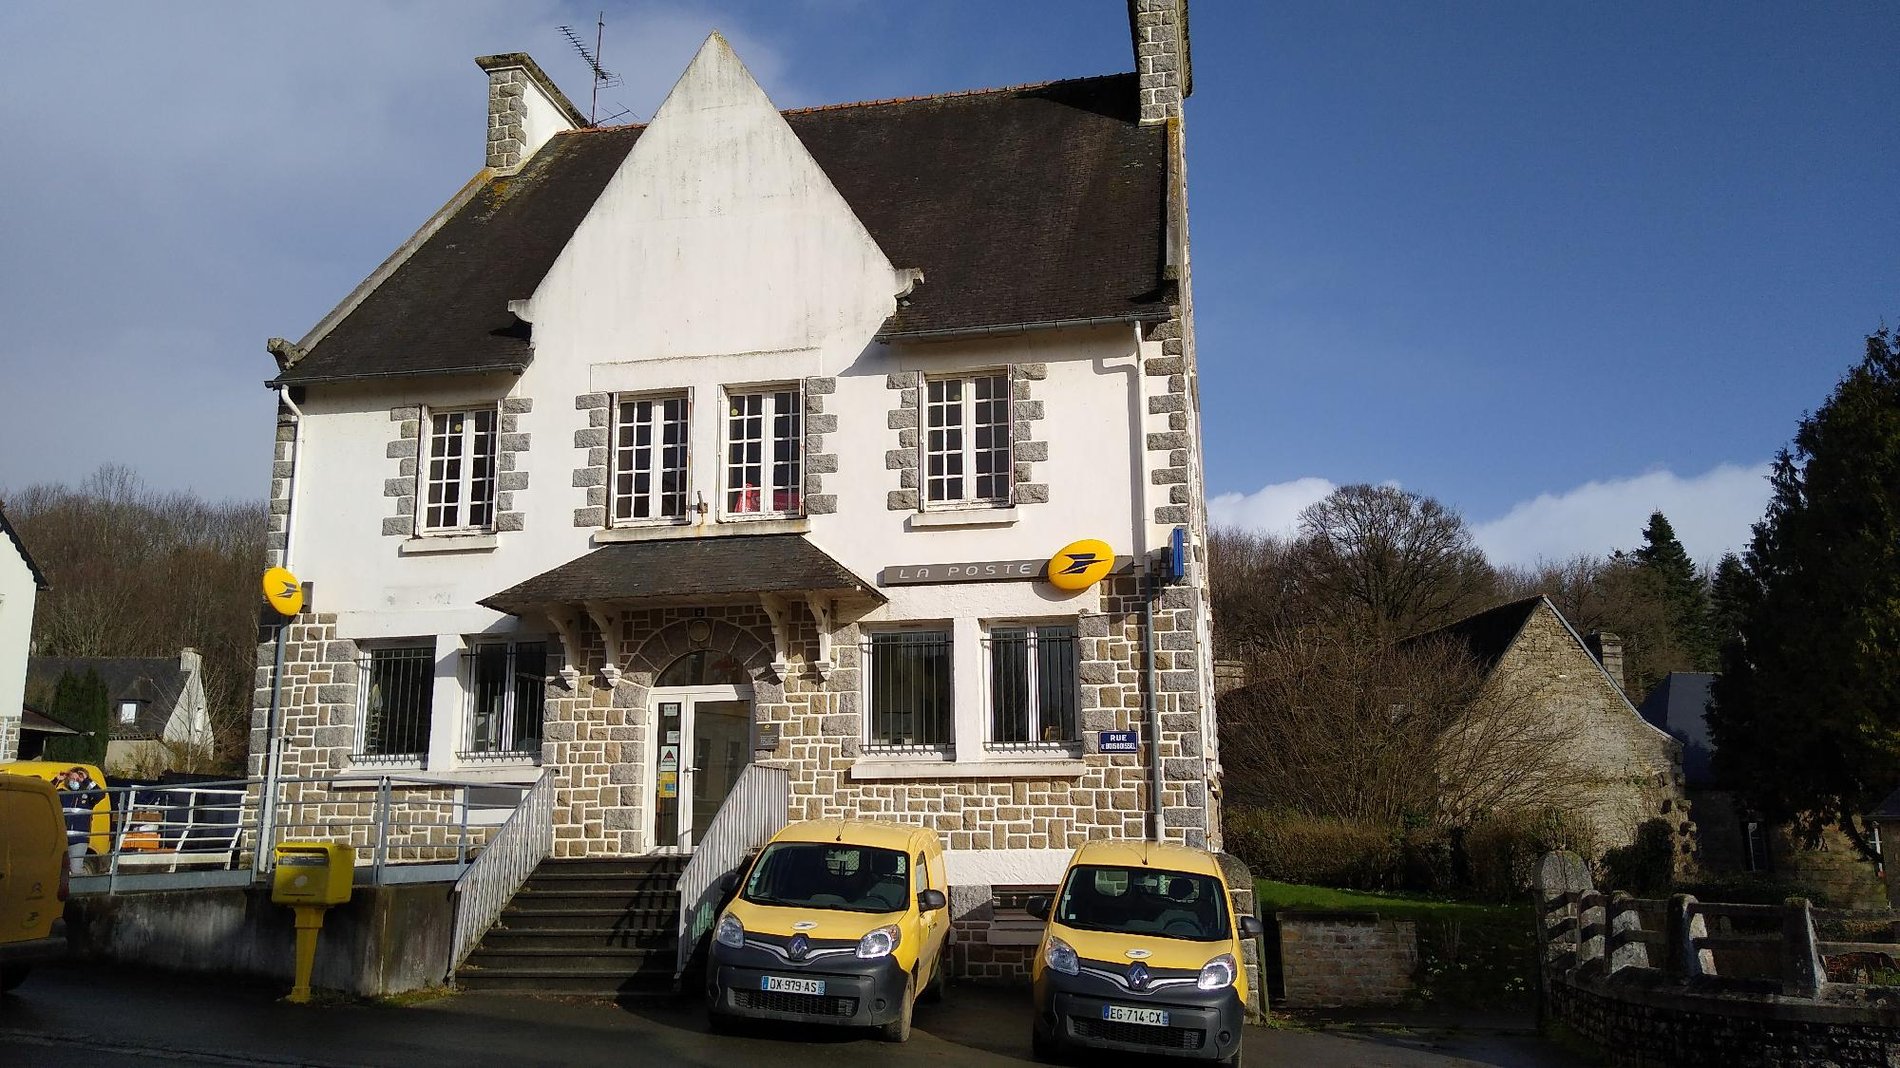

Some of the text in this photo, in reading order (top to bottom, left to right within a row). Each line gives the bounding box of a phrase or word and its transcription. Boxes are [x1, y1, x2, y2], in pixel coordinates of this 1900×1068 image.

[899, 563, 1033, 579] LA POSTE
[1110, 734, 1128, 742] RUE
